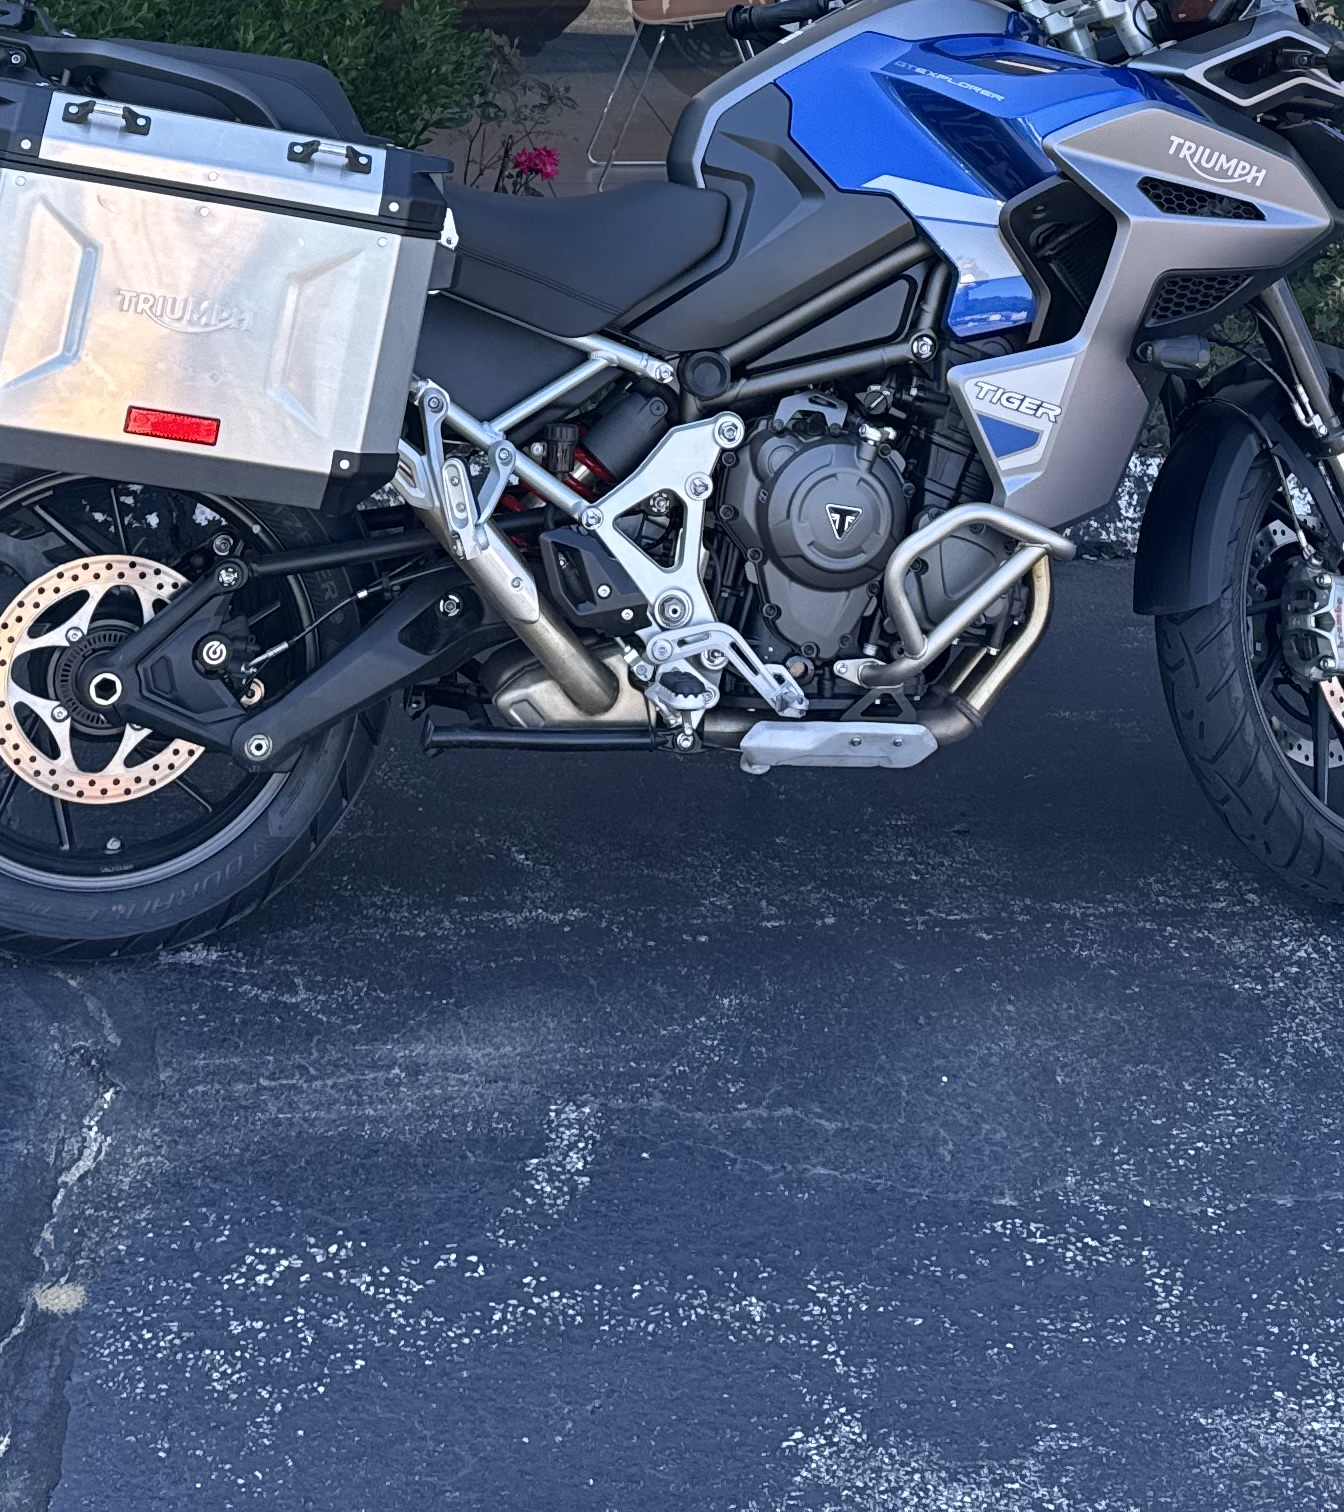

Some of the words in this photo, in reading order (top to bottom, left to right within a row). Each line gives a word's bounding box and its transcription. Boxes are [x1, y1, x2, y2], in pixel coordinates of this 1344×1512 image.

[1168, 134, 1267, 187] TRIUMPH
[119, 289, 256, 334] TRIUMPH
[975, 381, 1063, 423] TIGER
[1335, 597, 1344, 649] brembo
